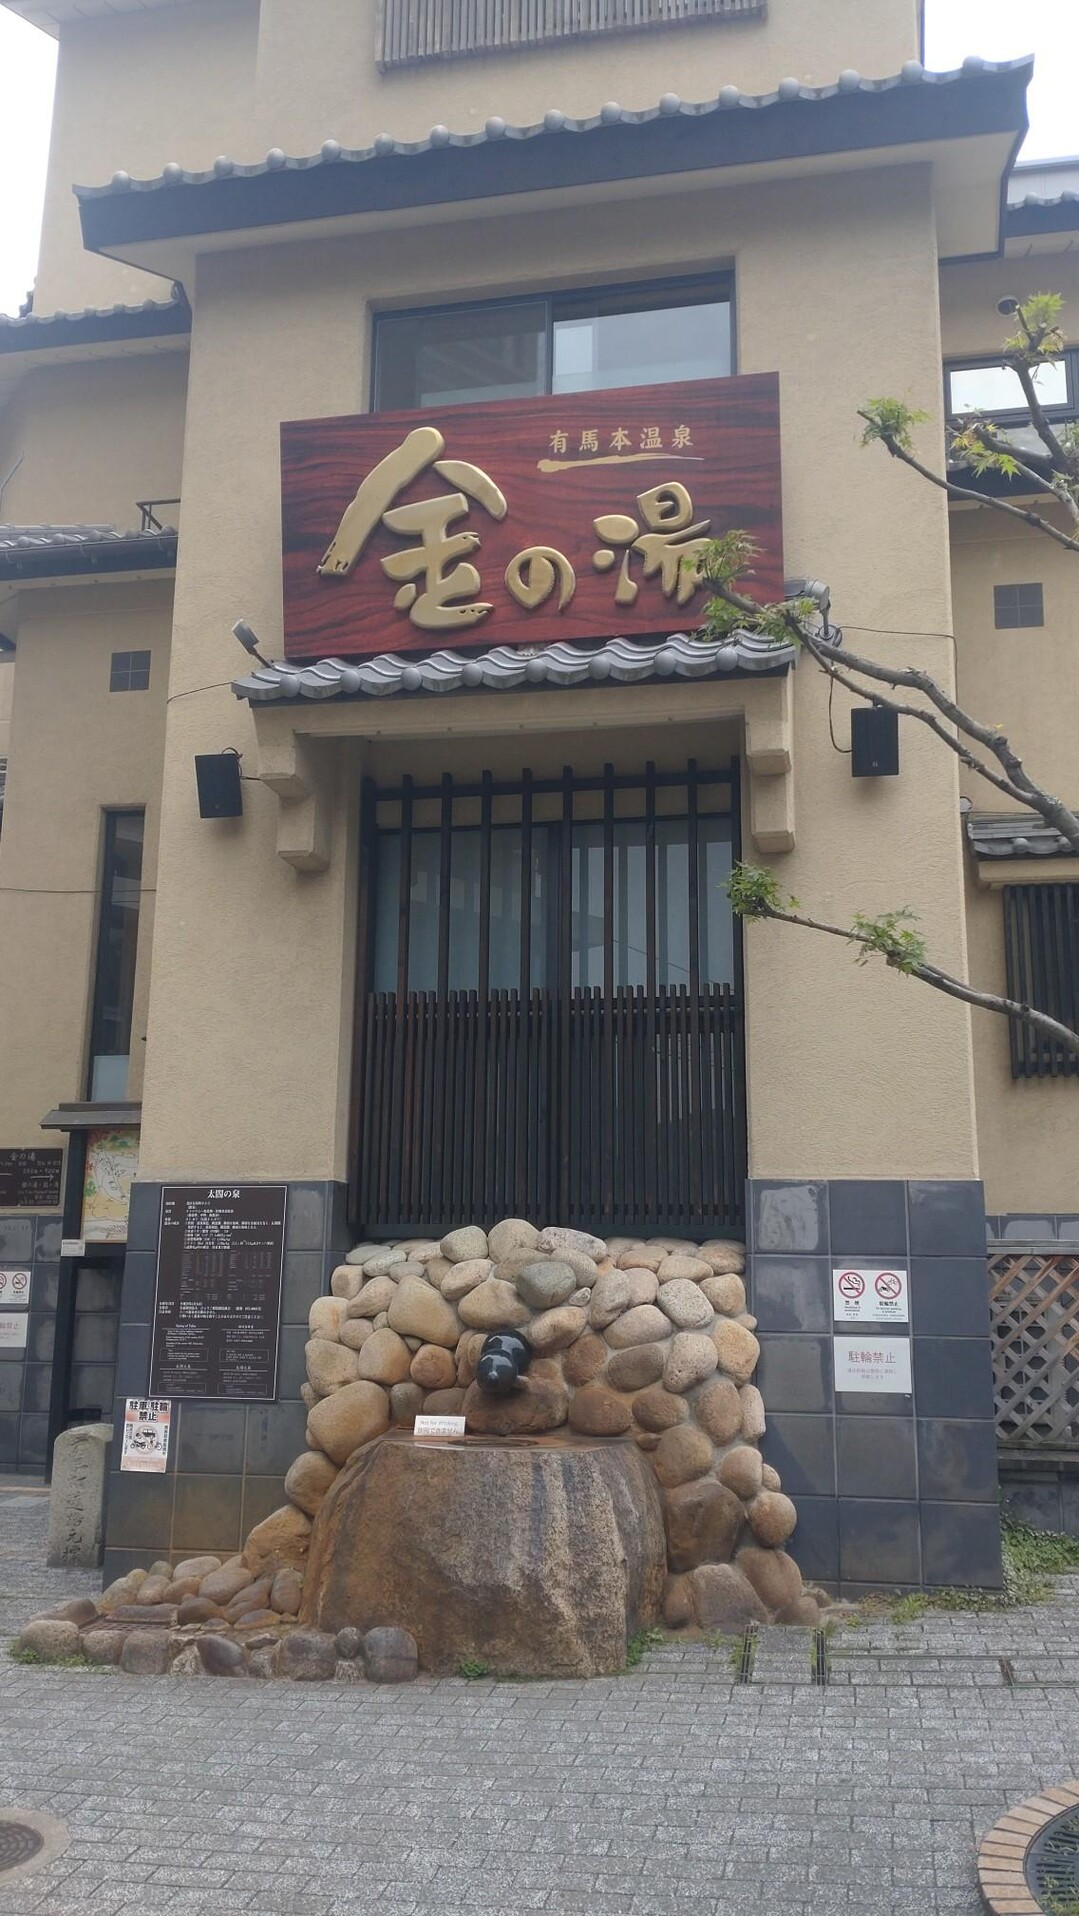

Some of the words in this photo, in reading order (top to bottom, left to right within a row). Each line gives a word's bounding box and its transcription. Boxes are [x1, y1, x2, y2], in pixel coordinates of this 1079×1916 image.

[549, 424, 694, 454] 有馬本温泉
[316, 426, 711, 630] 金の湯
[848, 1351, 896, 1364] 駐輪禁止
[139, 1411, 157, 1421] 禁止
